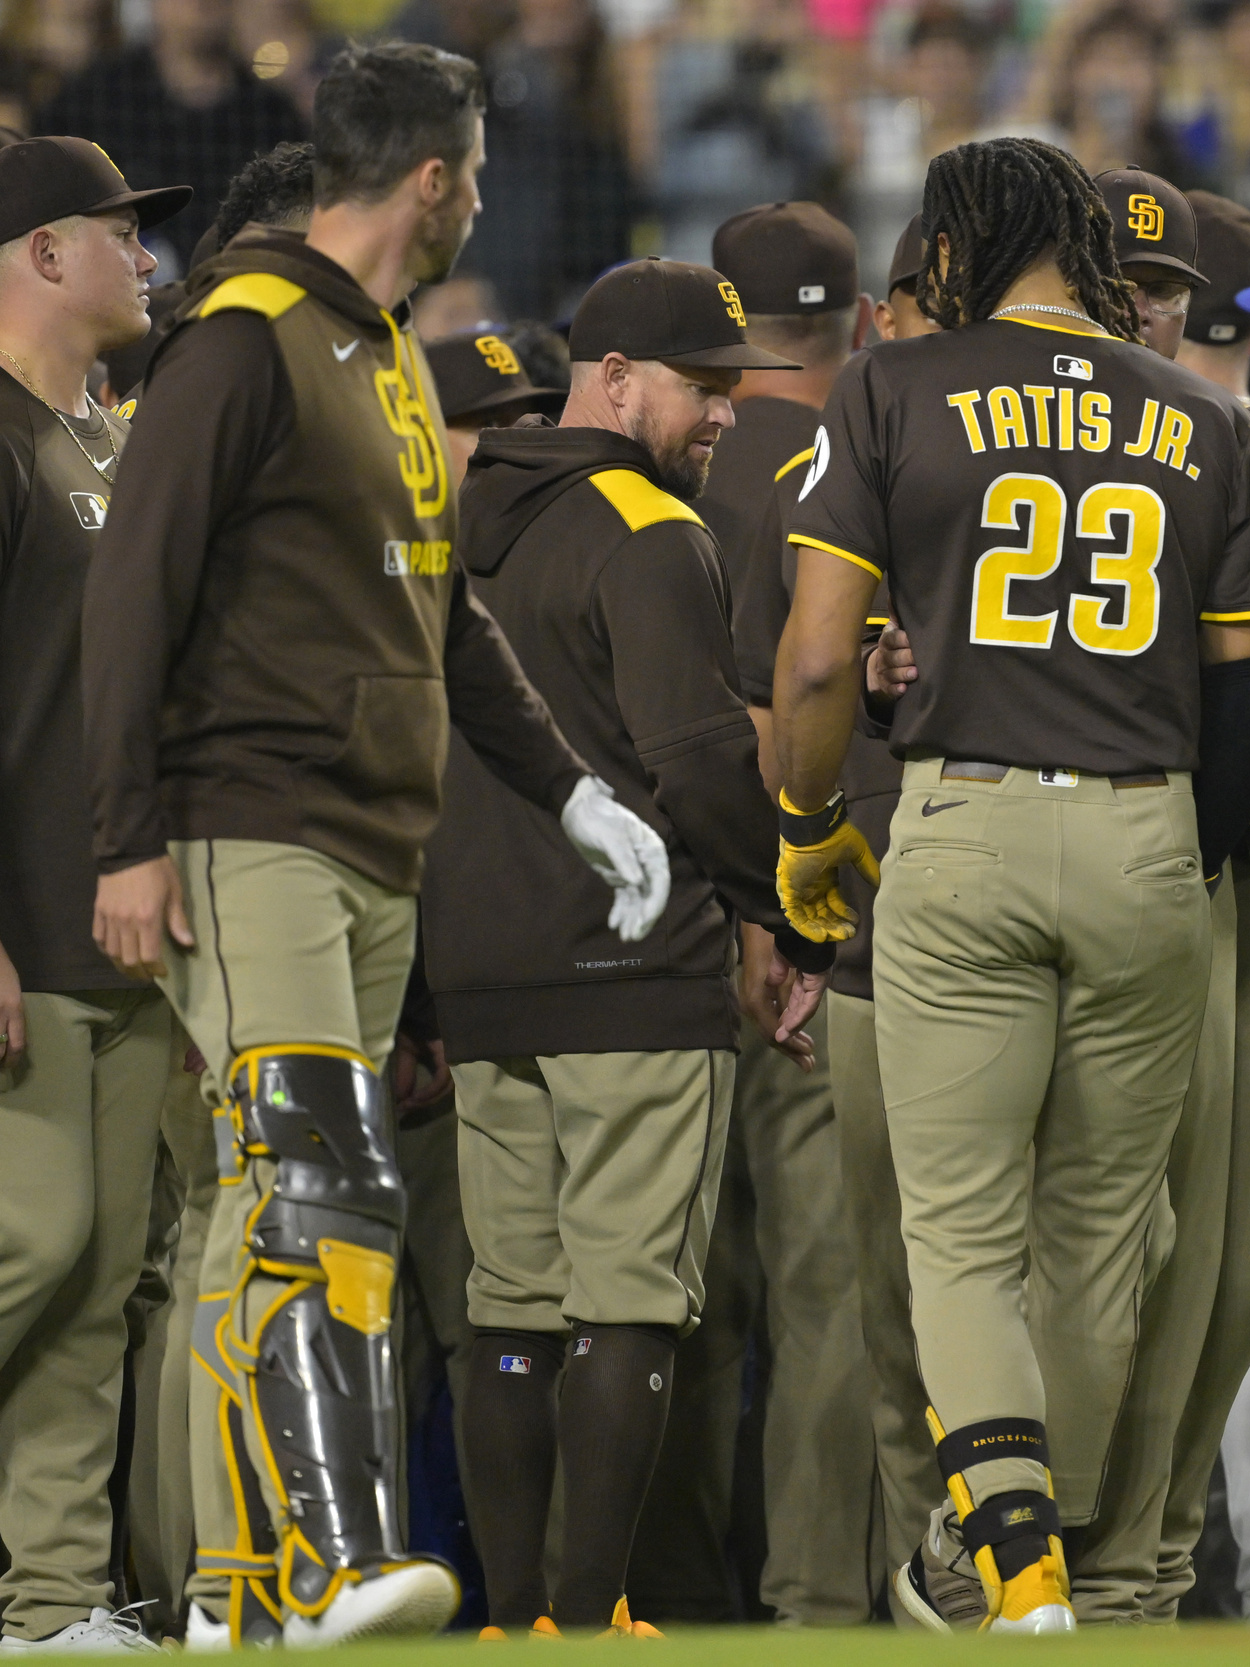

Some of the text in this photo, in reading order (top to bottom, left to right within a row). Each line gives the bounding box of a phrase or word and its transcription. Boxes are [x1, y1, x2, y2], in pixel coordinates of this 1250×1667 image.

[1127, 193, 1165, 242] SD
[946, 384, 1201, 482] TATIS JR.
[969, 472, 1166, 657] 23
[574, 958, 643, 970] THERMA-FIT
[972, 1434, 1014, 1448] BRUCE
